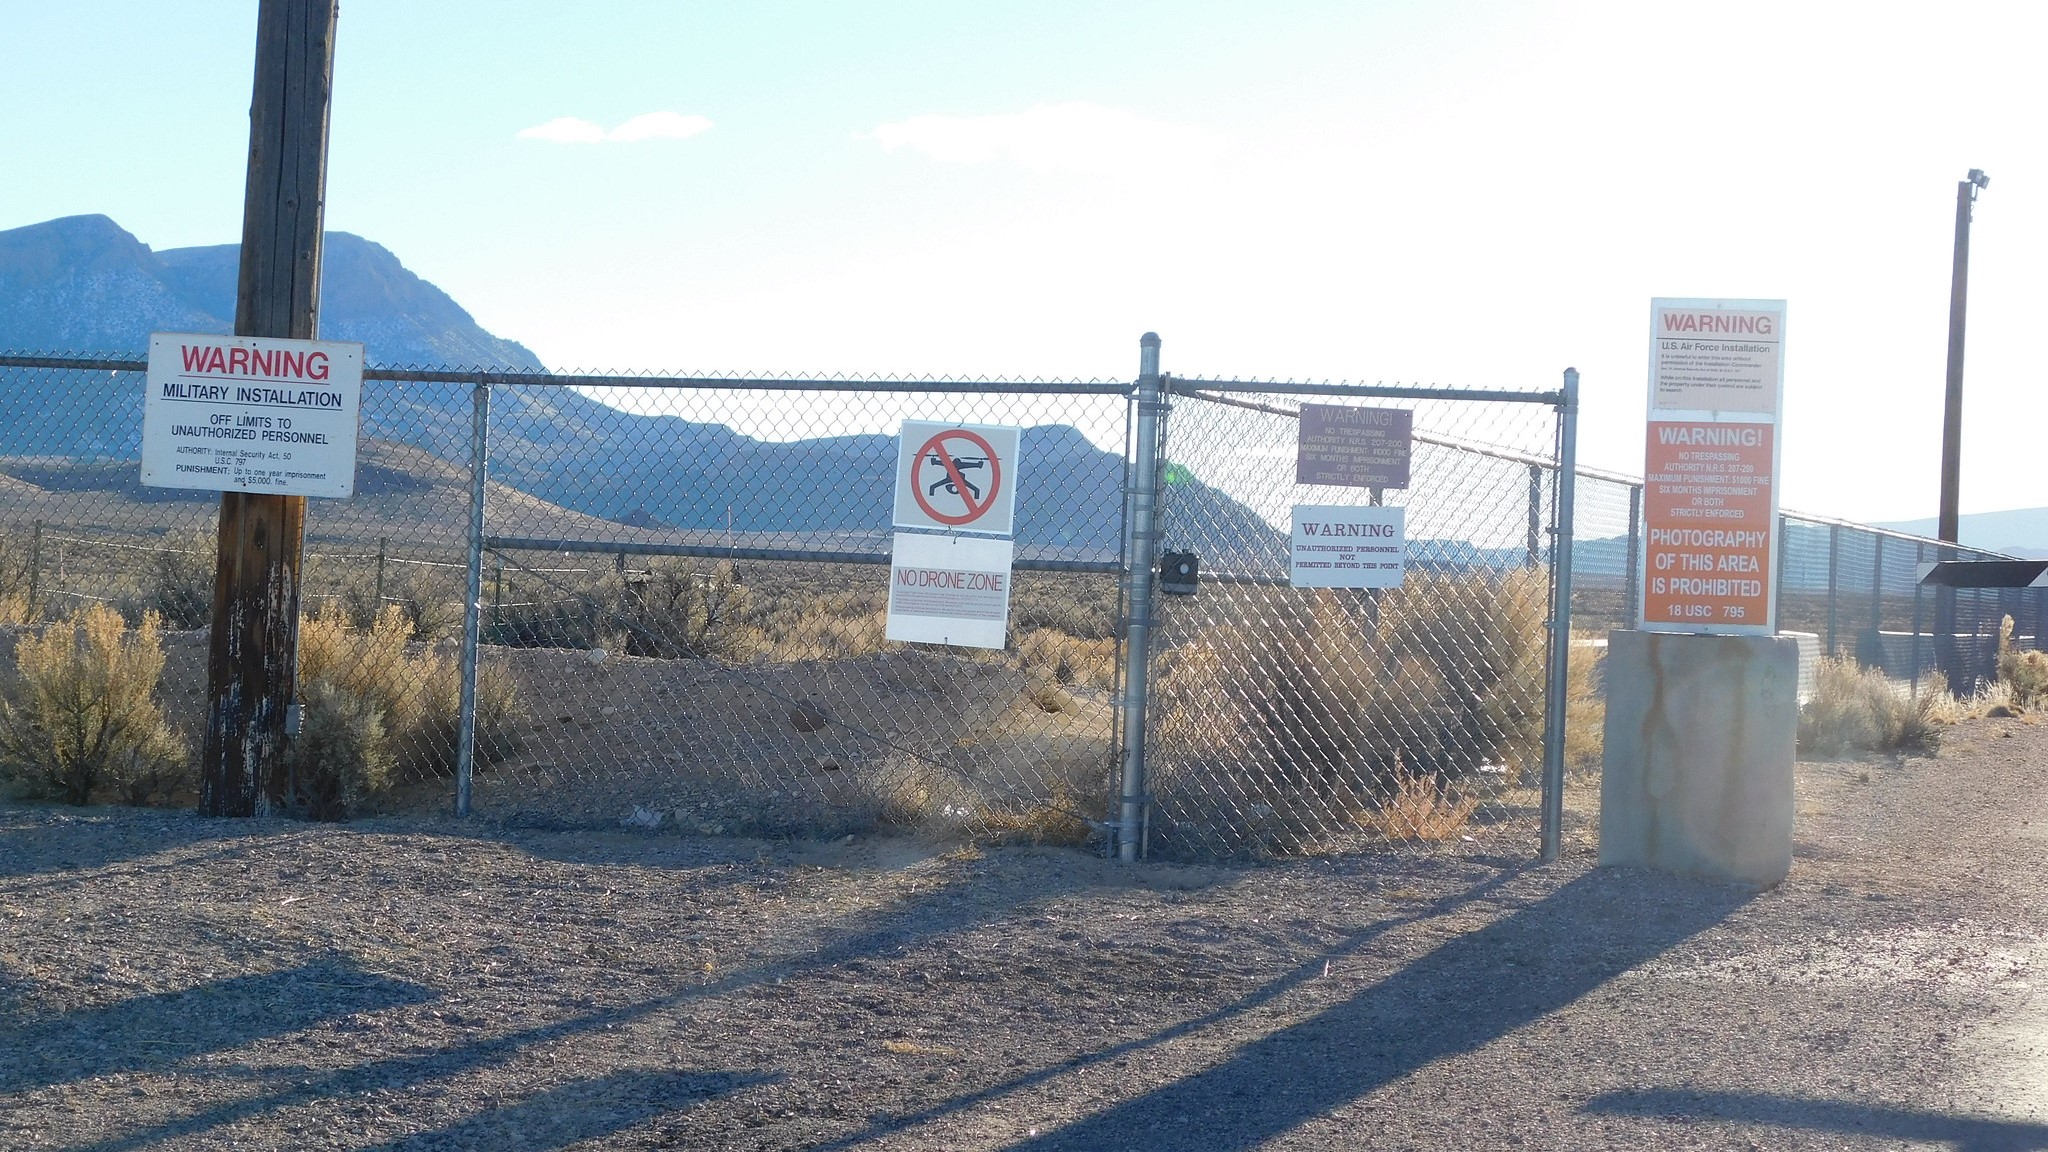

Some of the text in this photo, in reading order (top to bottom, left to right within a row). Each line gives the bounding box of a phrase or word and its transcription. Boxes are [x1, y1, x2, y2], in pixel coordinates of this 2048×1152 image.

[1664, 314, 1772, 334] WARNING
[1662, 342, 1678, 350] U.S.
[1694, 343, 1719, 351] Force
[1722, 344, 1770, 352] Installation
[181, 345, 329, 380] WARNING
[163, 383, 342, 407] MILITARY INSTALLATION
[210, 414, 291, 429] OFF LIMITS TO
[1320, 408, 1392, 425] WARNING!
[171, 425, 328, 445] UNAUTHORIZED PERSONNEL
[1340, 428, 1385, 437] TRESPASSING
[1659, 427, 1763, 447] WARNING!
[176, 446, 212, 455] AUTHORITY:
[240, 450, 265, 460] Security
[1320, 454, 1348, 462] MONTHS
[1353, 456, 1401, 465] IMPRISONMENT
[1679, 452, 1740, 461] NO TRESPASSING
[176, 464, 230, 475] PUNISHMENT:
[285, 471, 326, 479] imprisonment
[1664, 462, 1705, 471] AUTHORITY
[1316, 473, 1388, 482] STRICTLY ENFORCED
[1648, 473, 1770, 485] MAXIMUM PUNISHMENT: $1000 FINE
[1659, 485, 1757, 496] SIX MONTHS IMPRISONMENT
[1691, 497, 1724, 506] OR BOTH
[1671, 508, 1744, 518] STRICTLY ENFORCED
[1302, 523, 1395, 537] WARNING
[1650, 528, 1766, 549] PHOTOGRAPHY
[1656, 553, 1760, 572] OF THIS AREA
[897, 569, 1003, 591] NO DRONE ZONE
[1652, 577, 1760, 597] IS PROHIBITED
[1668, 604, 1744, 617] 18 USC 795
